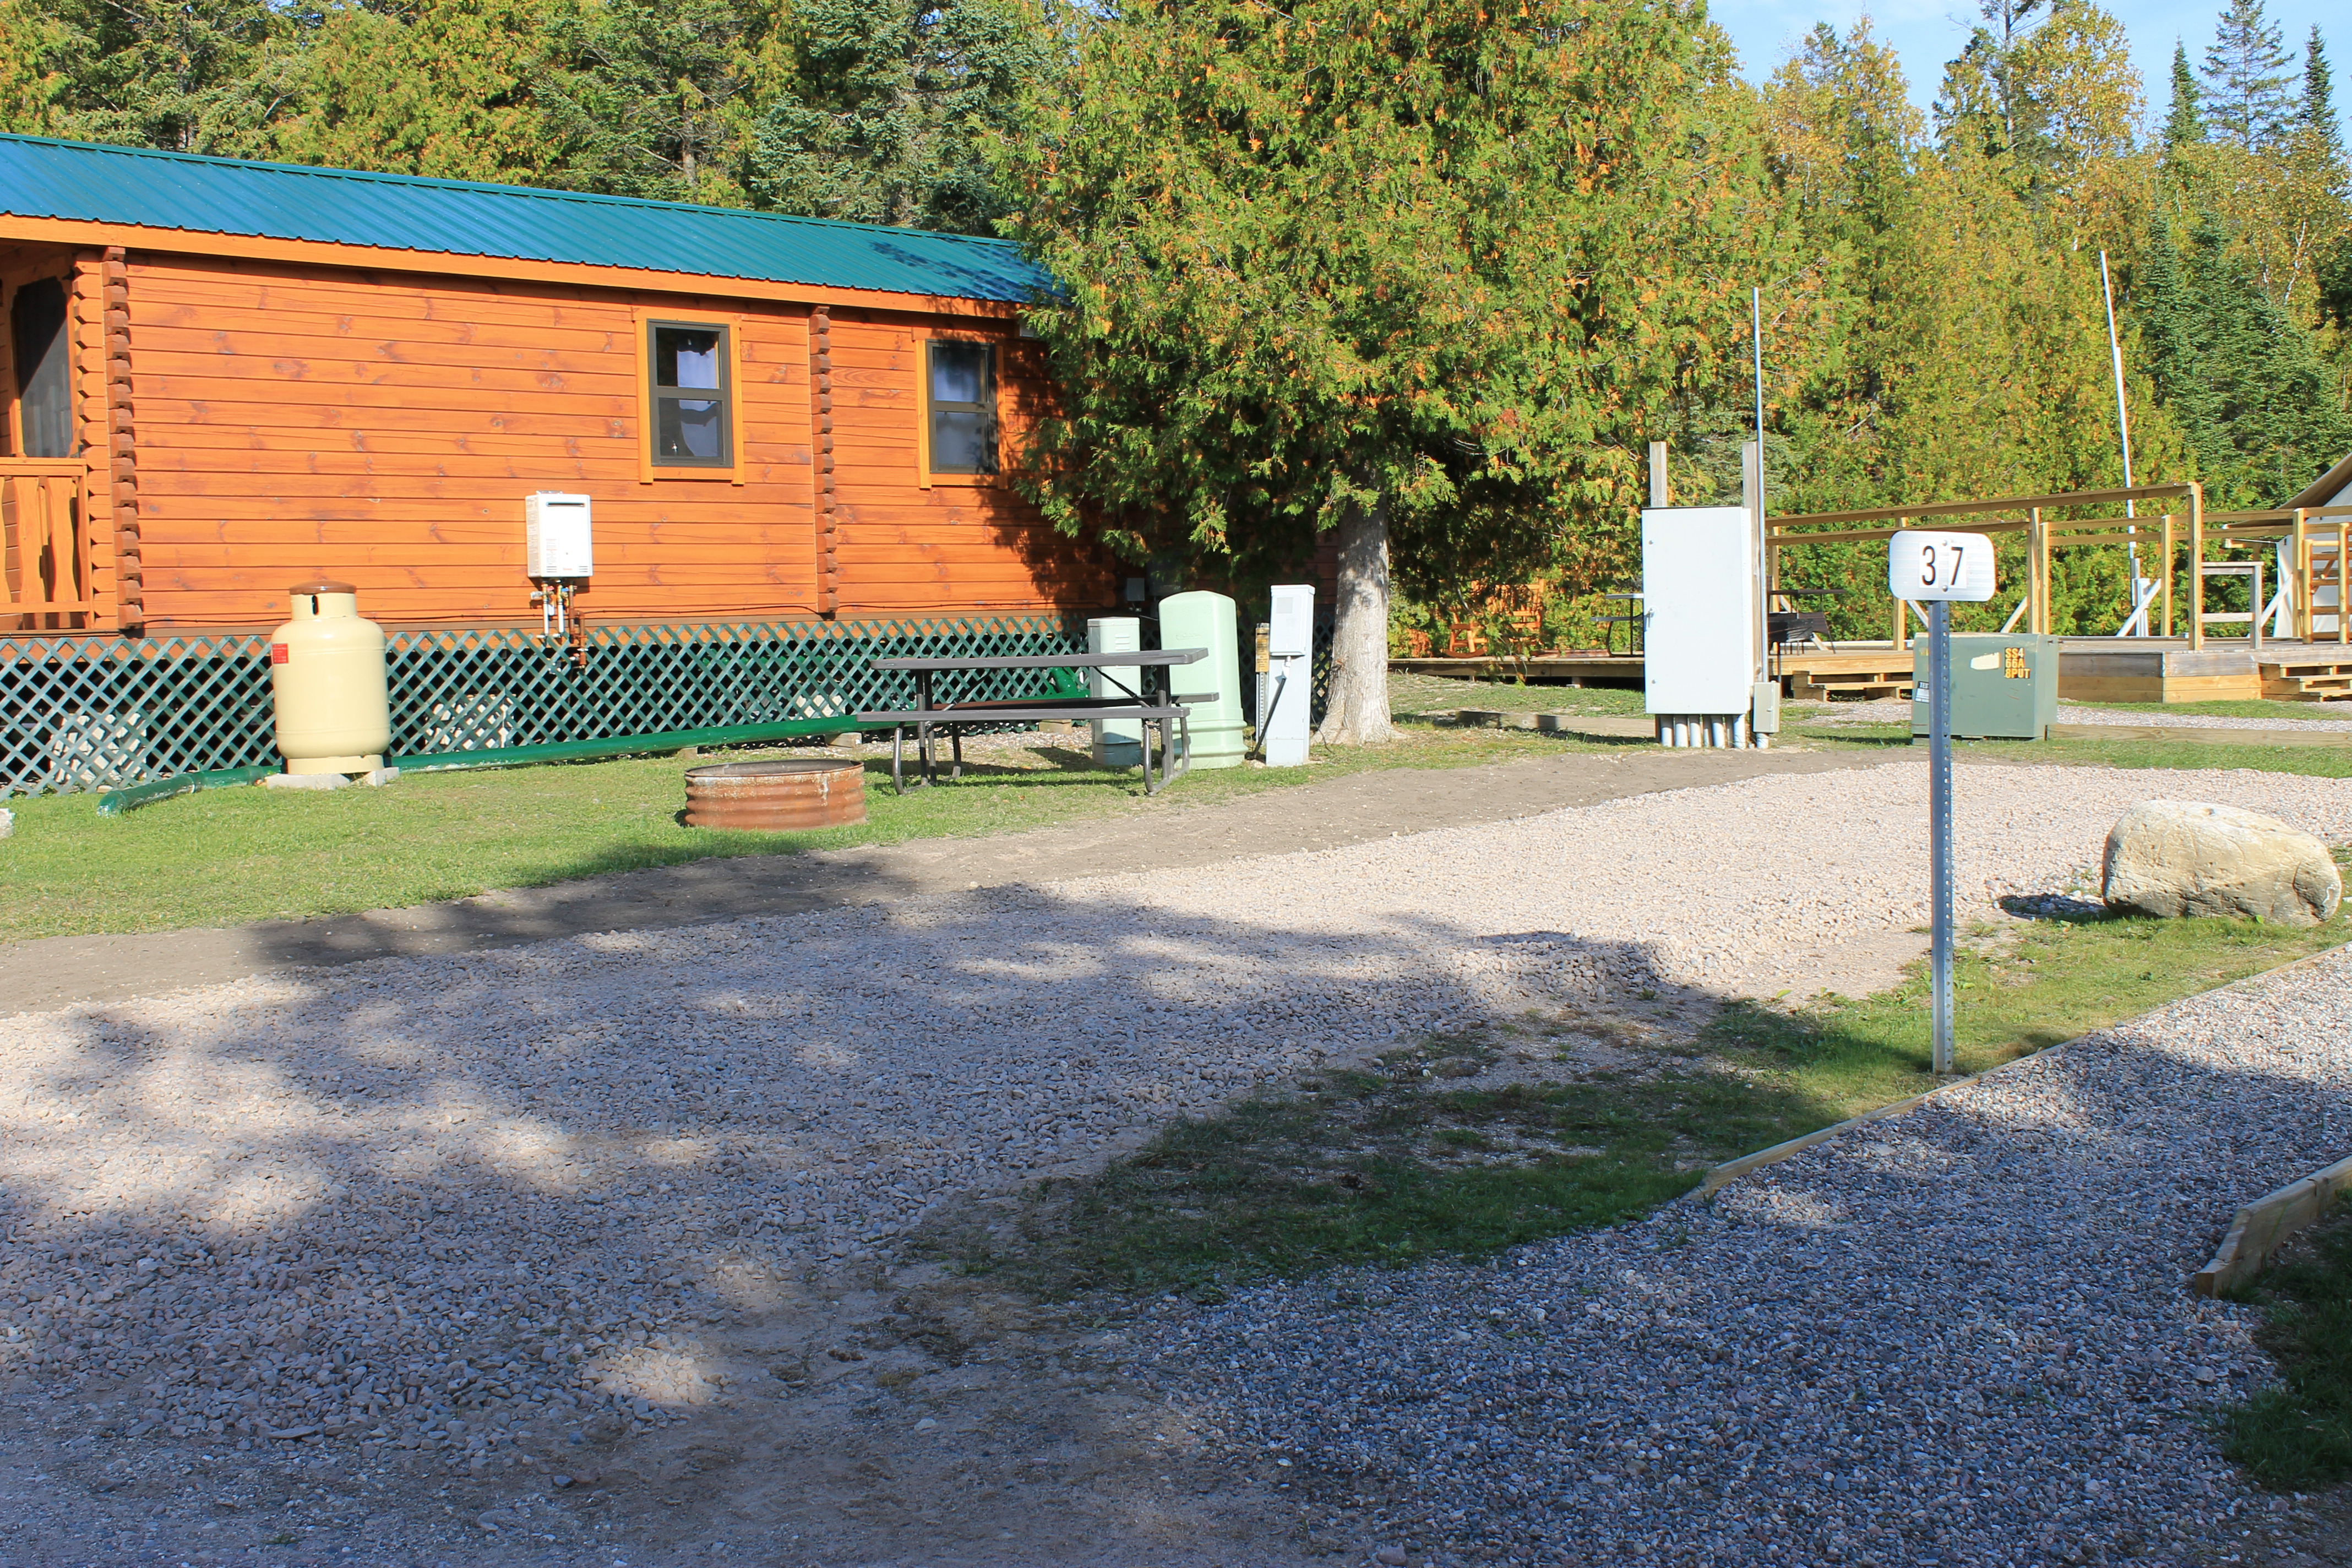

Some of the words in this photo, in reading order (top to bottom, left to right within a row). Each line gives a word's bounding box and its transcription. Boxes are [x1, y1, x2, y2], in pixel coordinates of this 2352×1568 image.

[1921, 545, 1964, 586] 37
[2005, 647, 2024, 658] SS4
[2005, 658, 2026, 668] 66A
[2005, 668, 2030, 678] 8PUT
